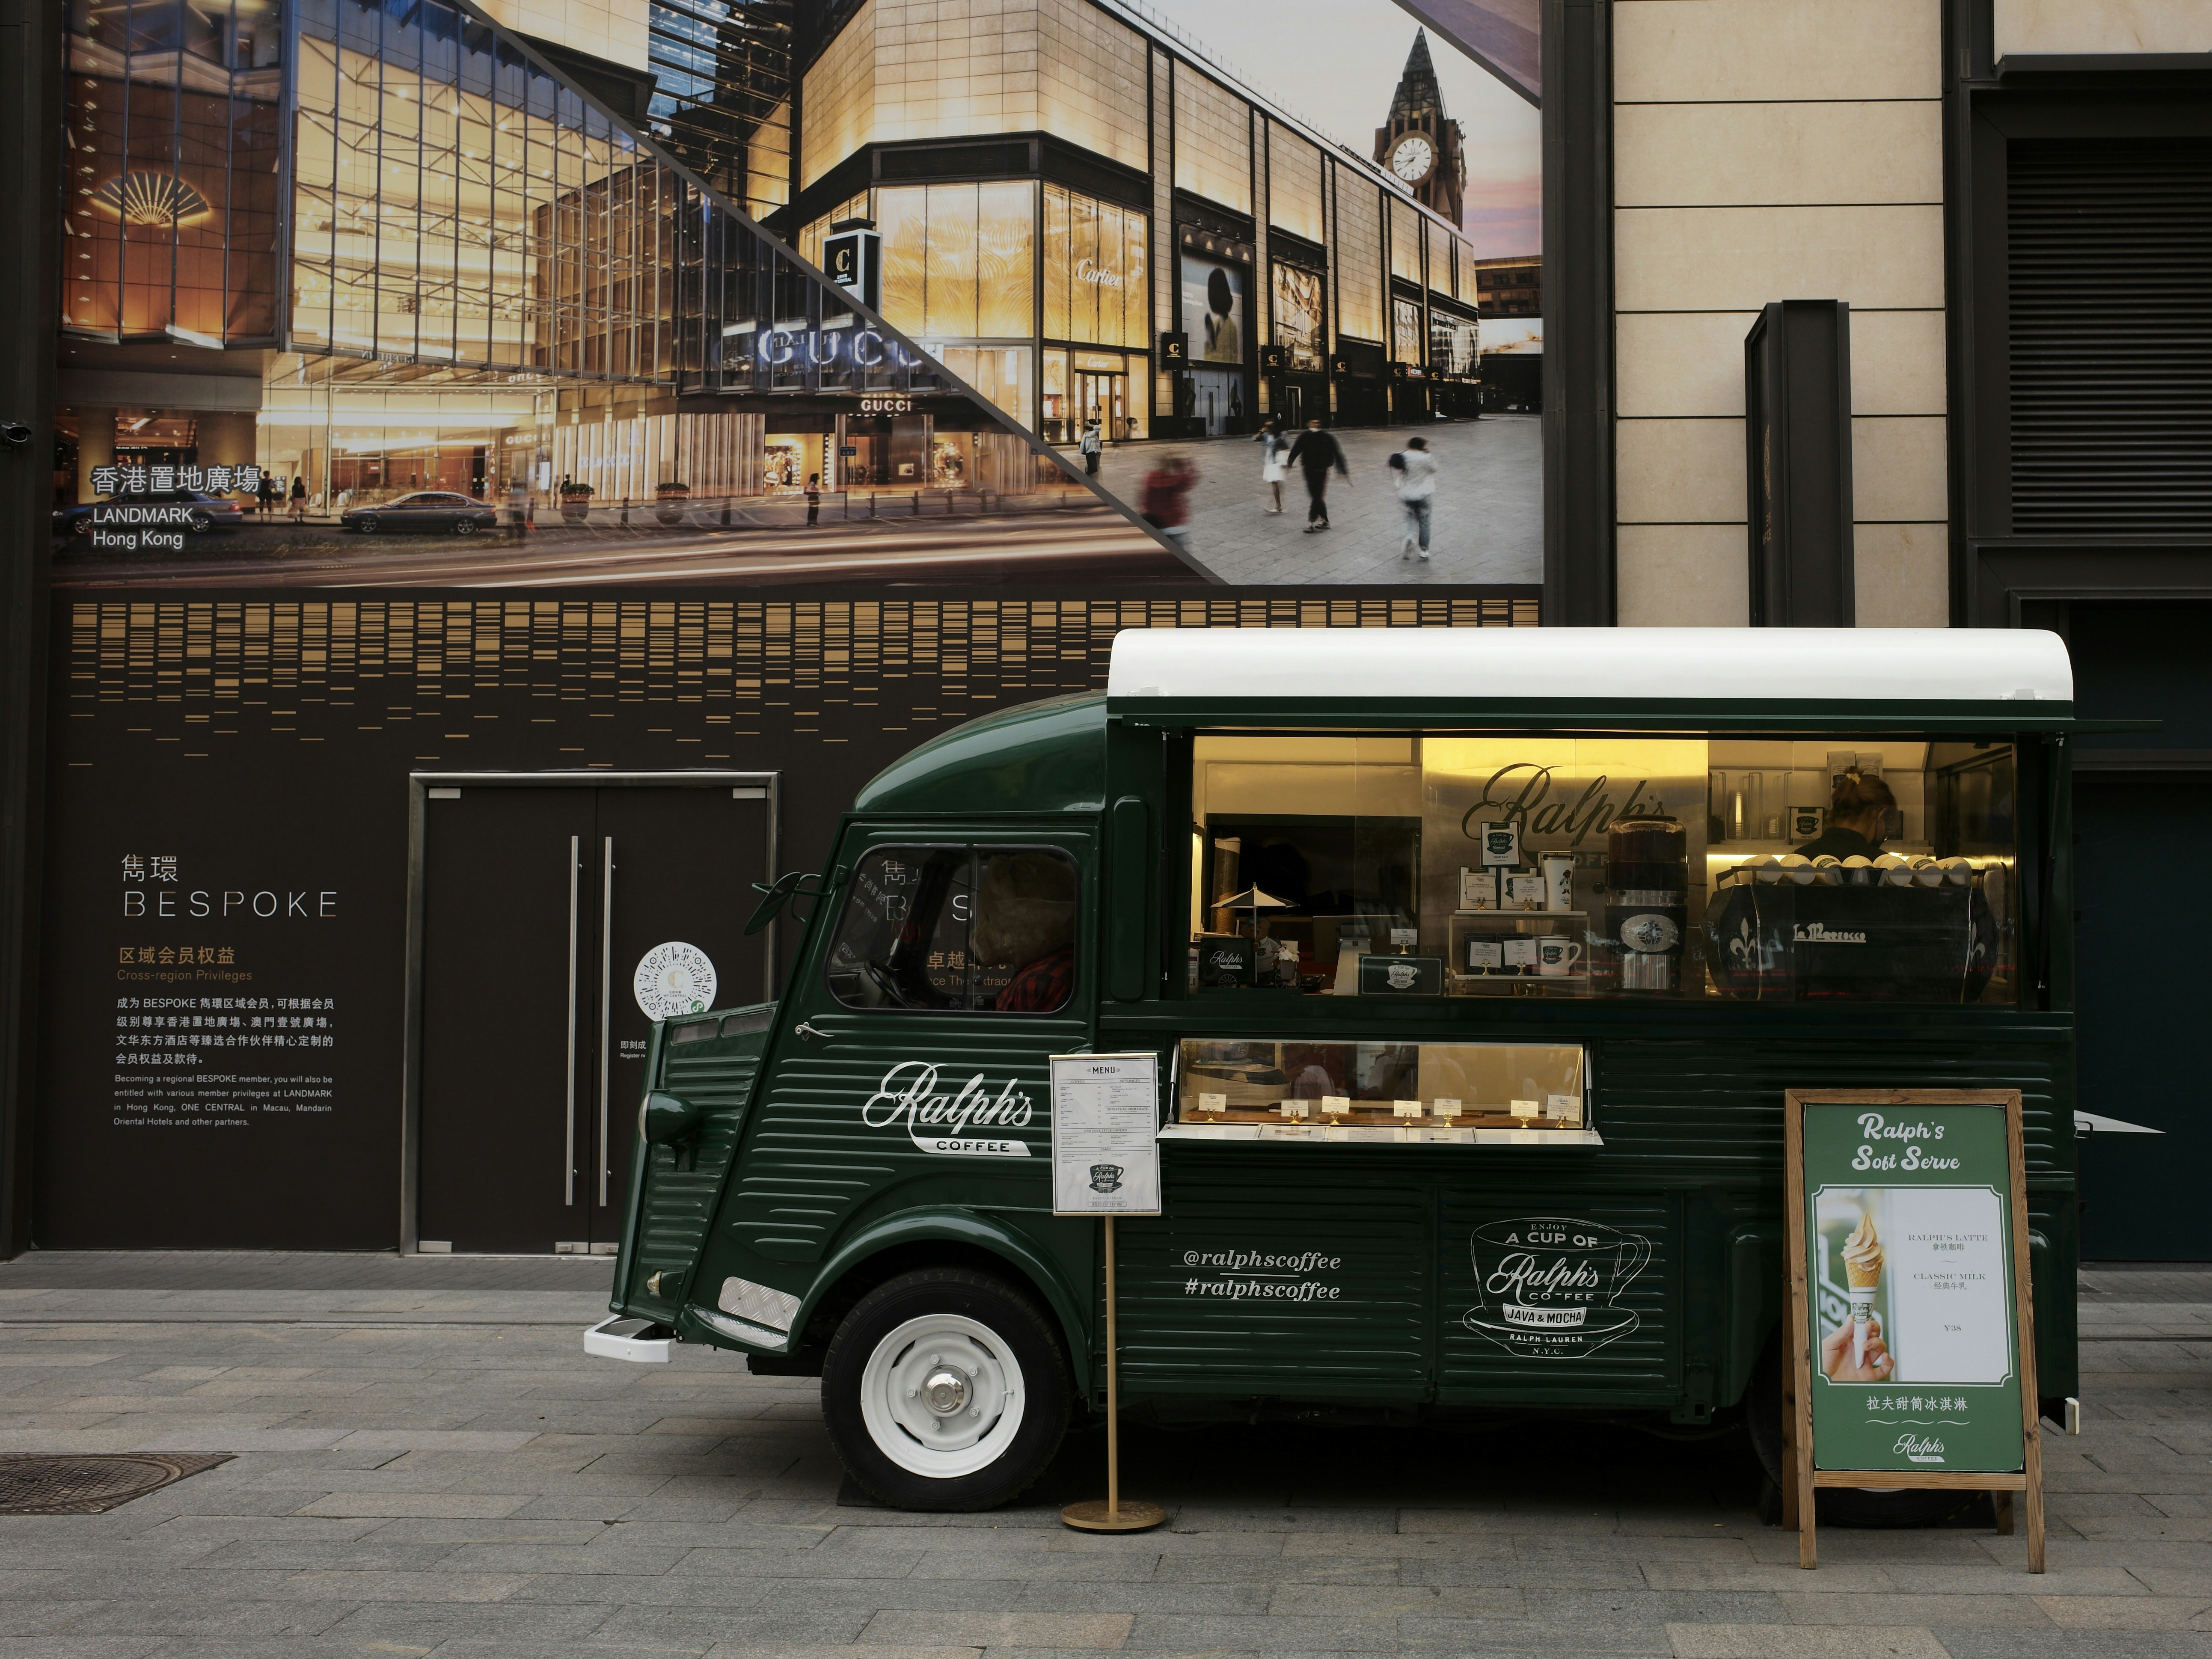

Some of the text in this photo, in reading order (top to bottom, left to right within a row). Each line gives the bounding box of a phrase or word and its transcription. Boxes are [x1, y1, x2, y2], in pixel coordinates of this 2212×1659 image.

[1076, 258, 1122, 287] Cartier
[1087, 356, 1108, 368] Cartier
[861, 400, 912, 411] GUCCI
[93, 508, 193, 523] LANDMARK
[93, 531, 183, 549] Hong Kong
[125, 891, 337, 917] BESPOKE
[1808, 922, 1866, 941] Marzocco
[120, 947, 235, 965] 区域会员权益
[1210, 951, 1243, 965] Ralph's
[117, 970, 252, 982] Cross-region Privileges
[117, 997, 139, 1009] 成为
[143, 998, 196, 1008] BESPOKE
[621, 1041, 646, 1049] 即刻成
[116, 1053, 203, 1065] 会员权益及款待。
[115, 1075, 154, 1084] Becoming
[163, 1075, 194, 1084] regional
[239, 1075, 272, 1083] member,
[274, 1077, 287, 1085] you
[233, 1089, 269, 1099] privileges
[862, 1061, 1033, 1136] Ralph's
[127, 1104, 147, 1113] Hong
[154, 1104, 175, 1113] Kong,
[263, 1104, 291, 1113] Macau,
[1857, 1113, 1945, 1143] Ralph's
[936, 1140, 1010, 1152] COFFEE
[1851, 1145, 1960, 1171] Soft Serve
[1093, 1172, 1115, 1183] Ralph's
[1505, 1232, 1598, 1248] A CUP OF
[1932, 1243, 1964, 1252] 拿铁咖啡
[1184, 1249, 1341, 1272] @ralphscoffee
[1486, 1253, 1598, 1306] Ralph's
[1934, 1282, 1967, 1290] 经典牛乳
[1185, 1279, 1340, 1301] #ralphscoffee
[1508, 1309, 1535, 1323] JAVA
[1547, 1312, 1582, 1324] MOCHA
[1510, 1334, 1540, 1342] RALPH
[1866, 1396, 1968, 1412] 拉夫甜筒冰淇淋
[1893, 1433, 1945, 1456] Ralph's
